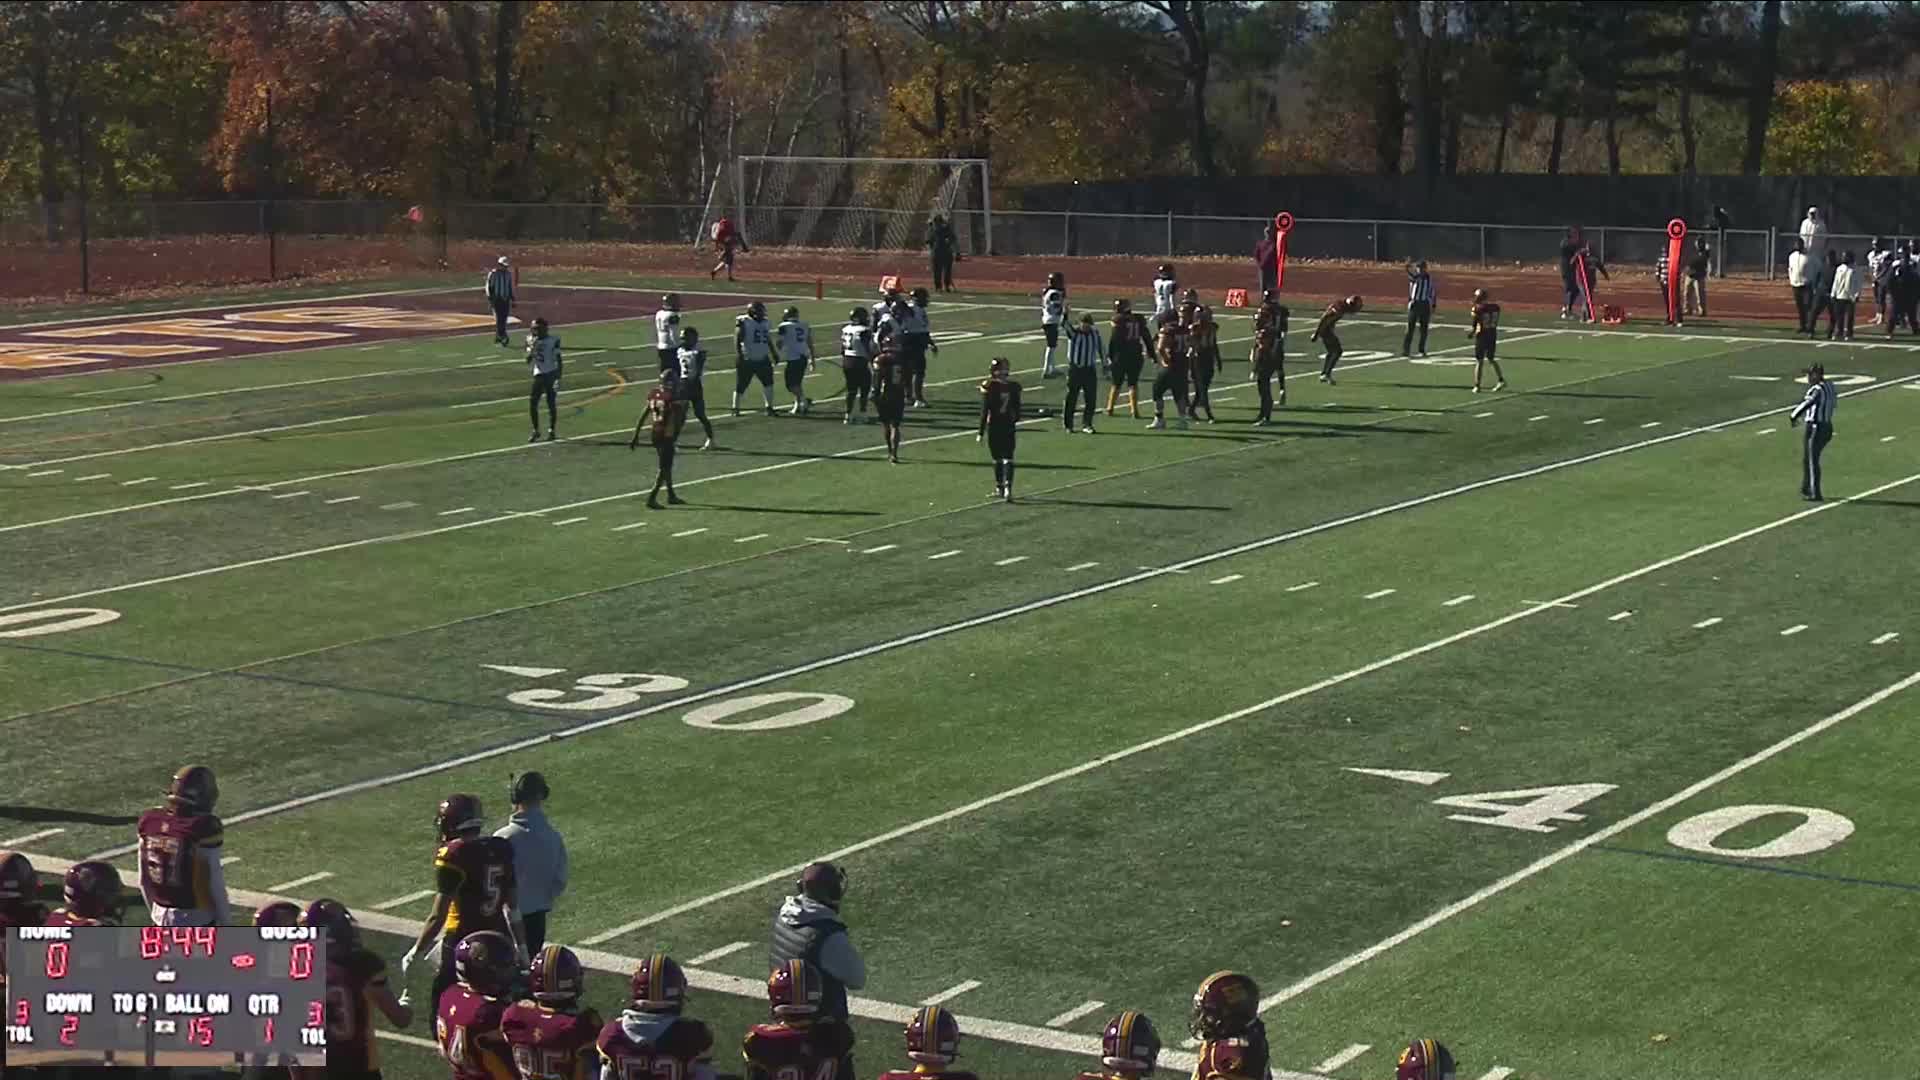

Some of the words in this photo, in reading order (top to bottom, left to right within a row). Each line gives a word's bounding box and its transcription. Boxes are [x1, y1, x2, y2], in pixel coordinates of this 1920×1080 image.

[999, 392, 1009, 414] 7
[1432, 782, 1855, 858] 40
[480, 864, 504, 917] 5
